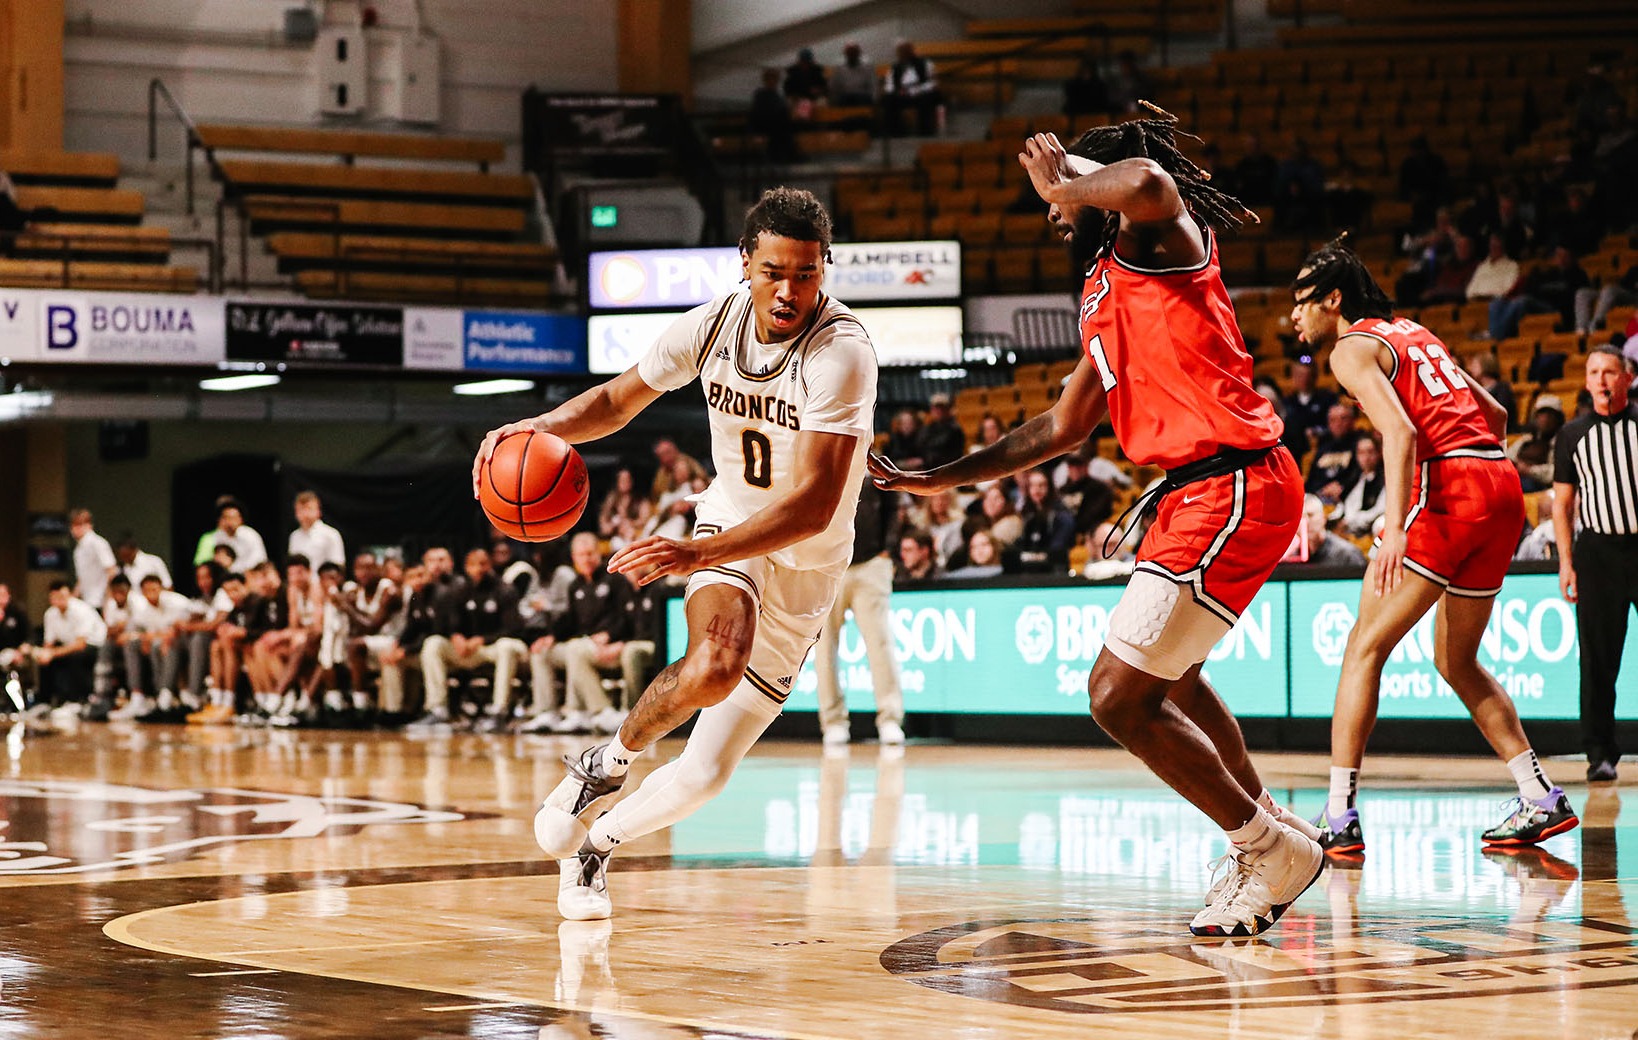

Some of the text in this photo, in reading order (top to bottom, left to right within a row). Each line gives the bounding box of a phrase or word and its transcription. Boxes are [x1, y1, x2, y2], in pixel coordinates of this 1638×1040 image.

[834, 270, 894, 285] FORD
[47, 305, 79, 350] B
[91, 305, 195, 332] BOUMA
[1406, 343, 1469, 397] 22
[707, 381, 801, 432] BRONCOS
[740, 426, 775, 491] 0
[1437, 953, 1638, 981] 946
